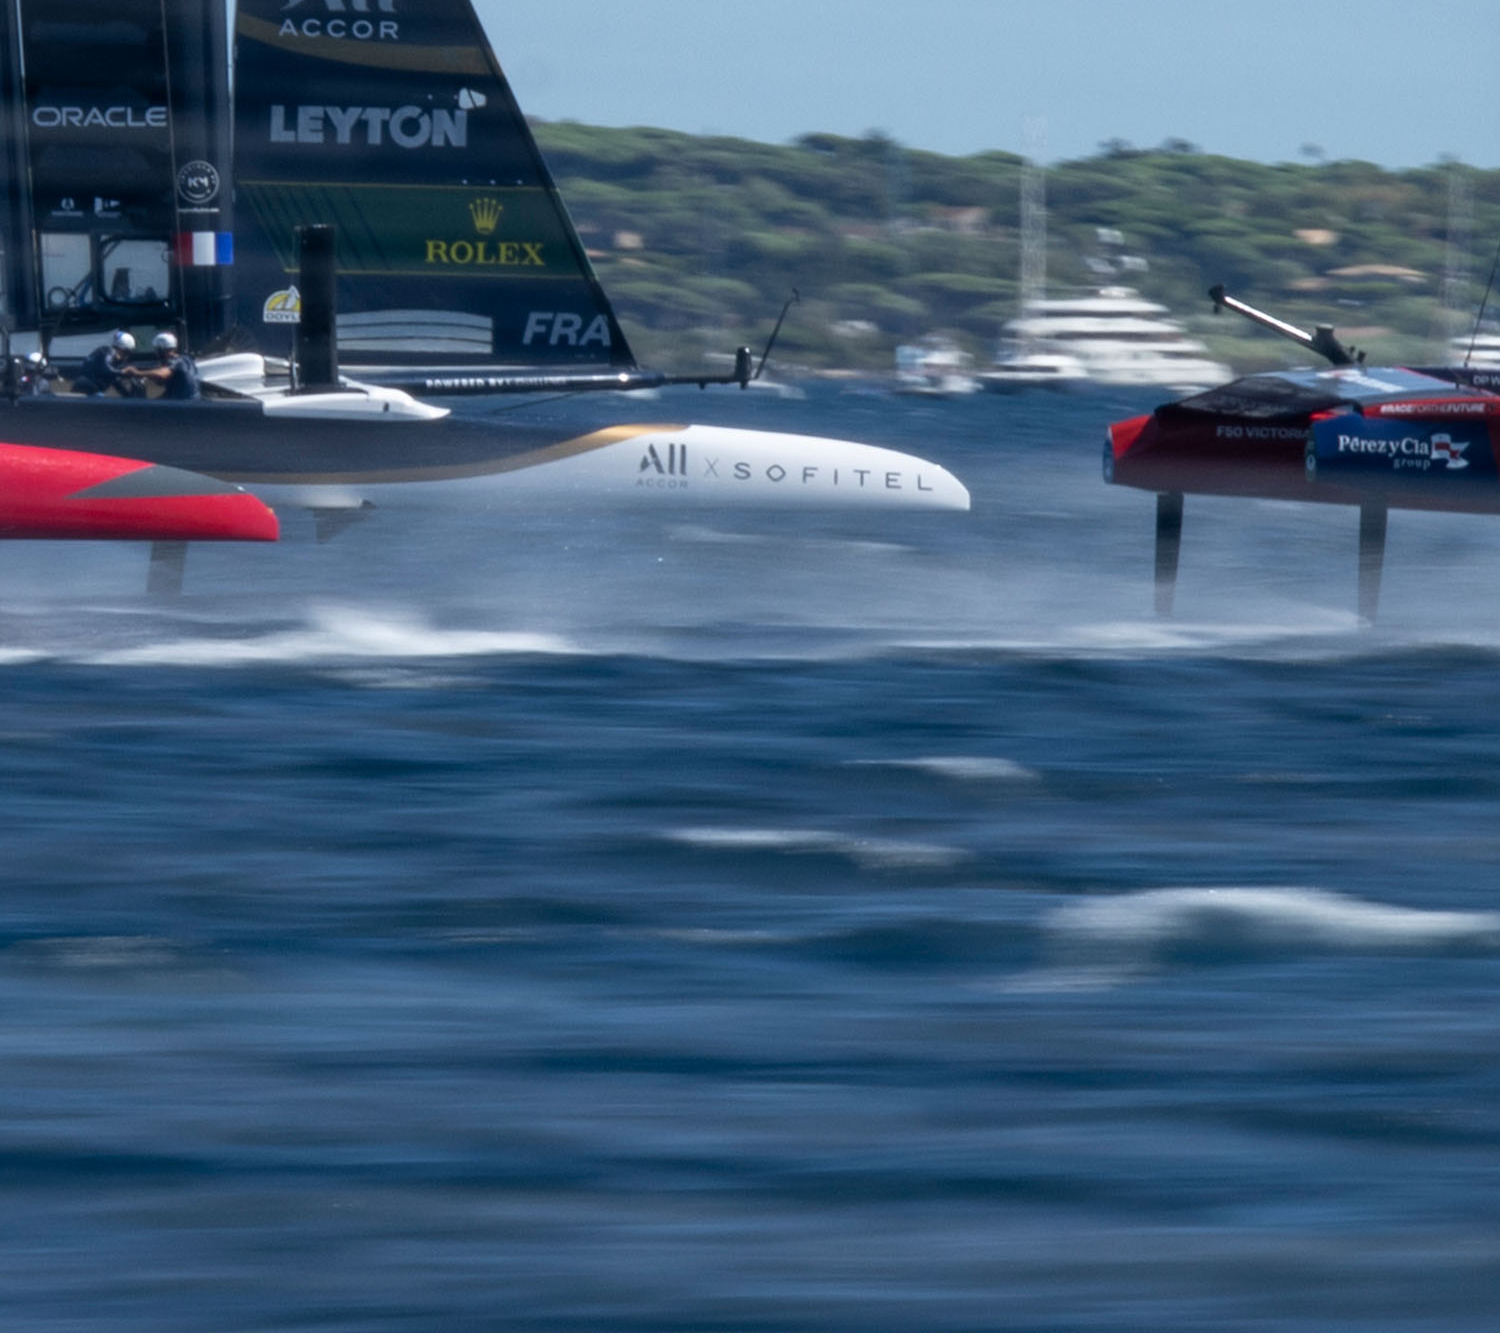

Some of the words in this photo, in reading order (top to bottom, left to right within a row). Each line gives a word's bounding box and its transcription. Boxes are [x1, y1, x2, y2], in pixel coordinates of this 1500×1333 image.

[278, 17, 400, 39] ACCOR
[32, 104, 168, 128] ORACLE
[269, 104, 468, 150] LEYTON
[424, 238, 545, 267] ROLEX
[266, 312, 298, 321] DOYL
[522, 311, 613, 349] FRA
[732, 461, 934, 493] SOFITEL
